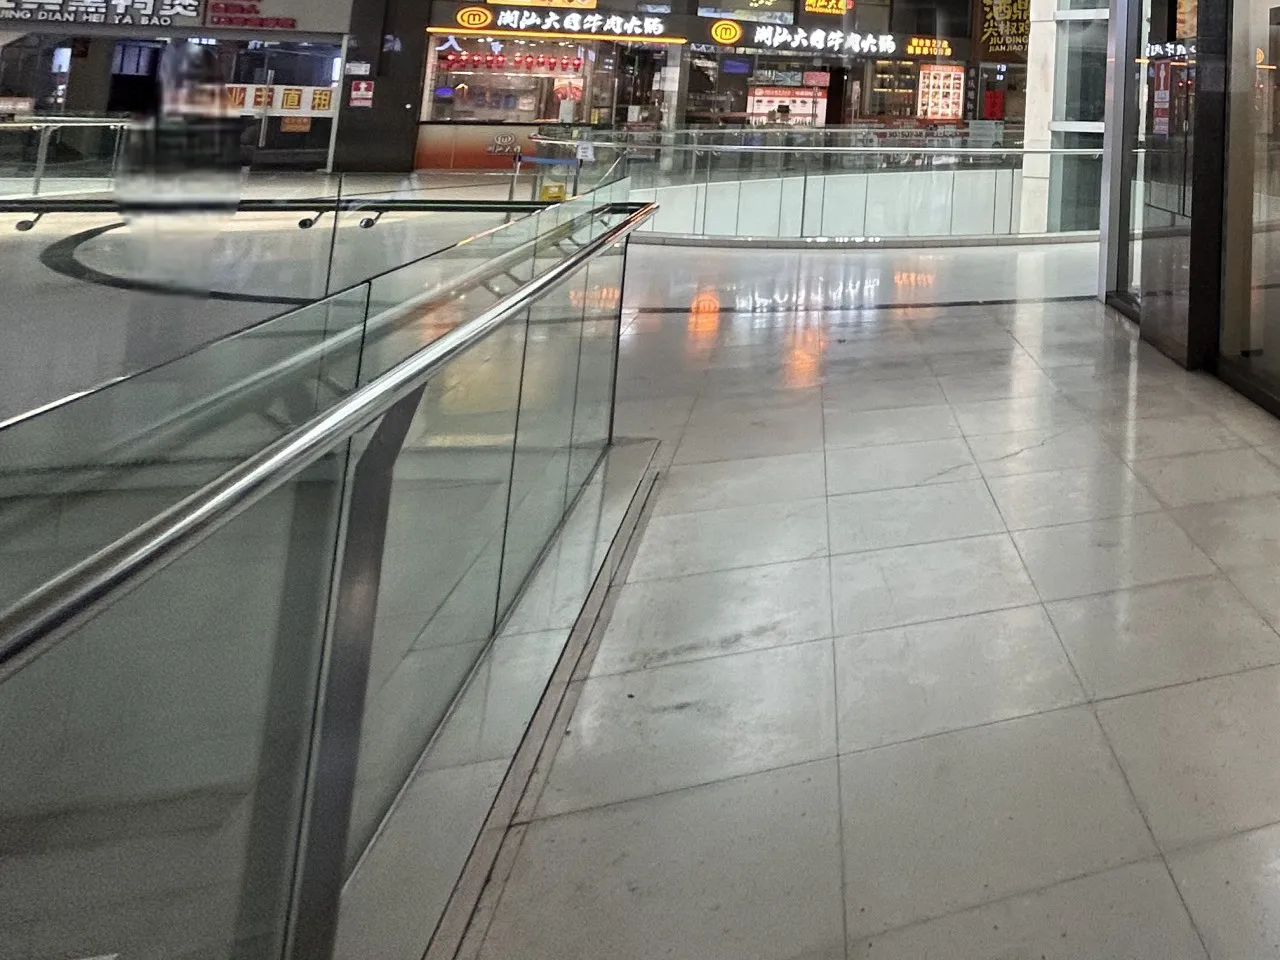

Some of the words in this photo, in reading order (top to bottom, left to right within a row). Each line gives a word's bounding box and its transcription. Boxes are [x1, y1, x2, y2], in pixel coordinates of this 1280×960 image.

[38, 11, 75, 23] DIAN
[83, 12, 105, 23] HEI
[114, 14, 133, 25] YA
[141, 15, 171, 26] BAO
[990, 36, 1004, 44] JIU
